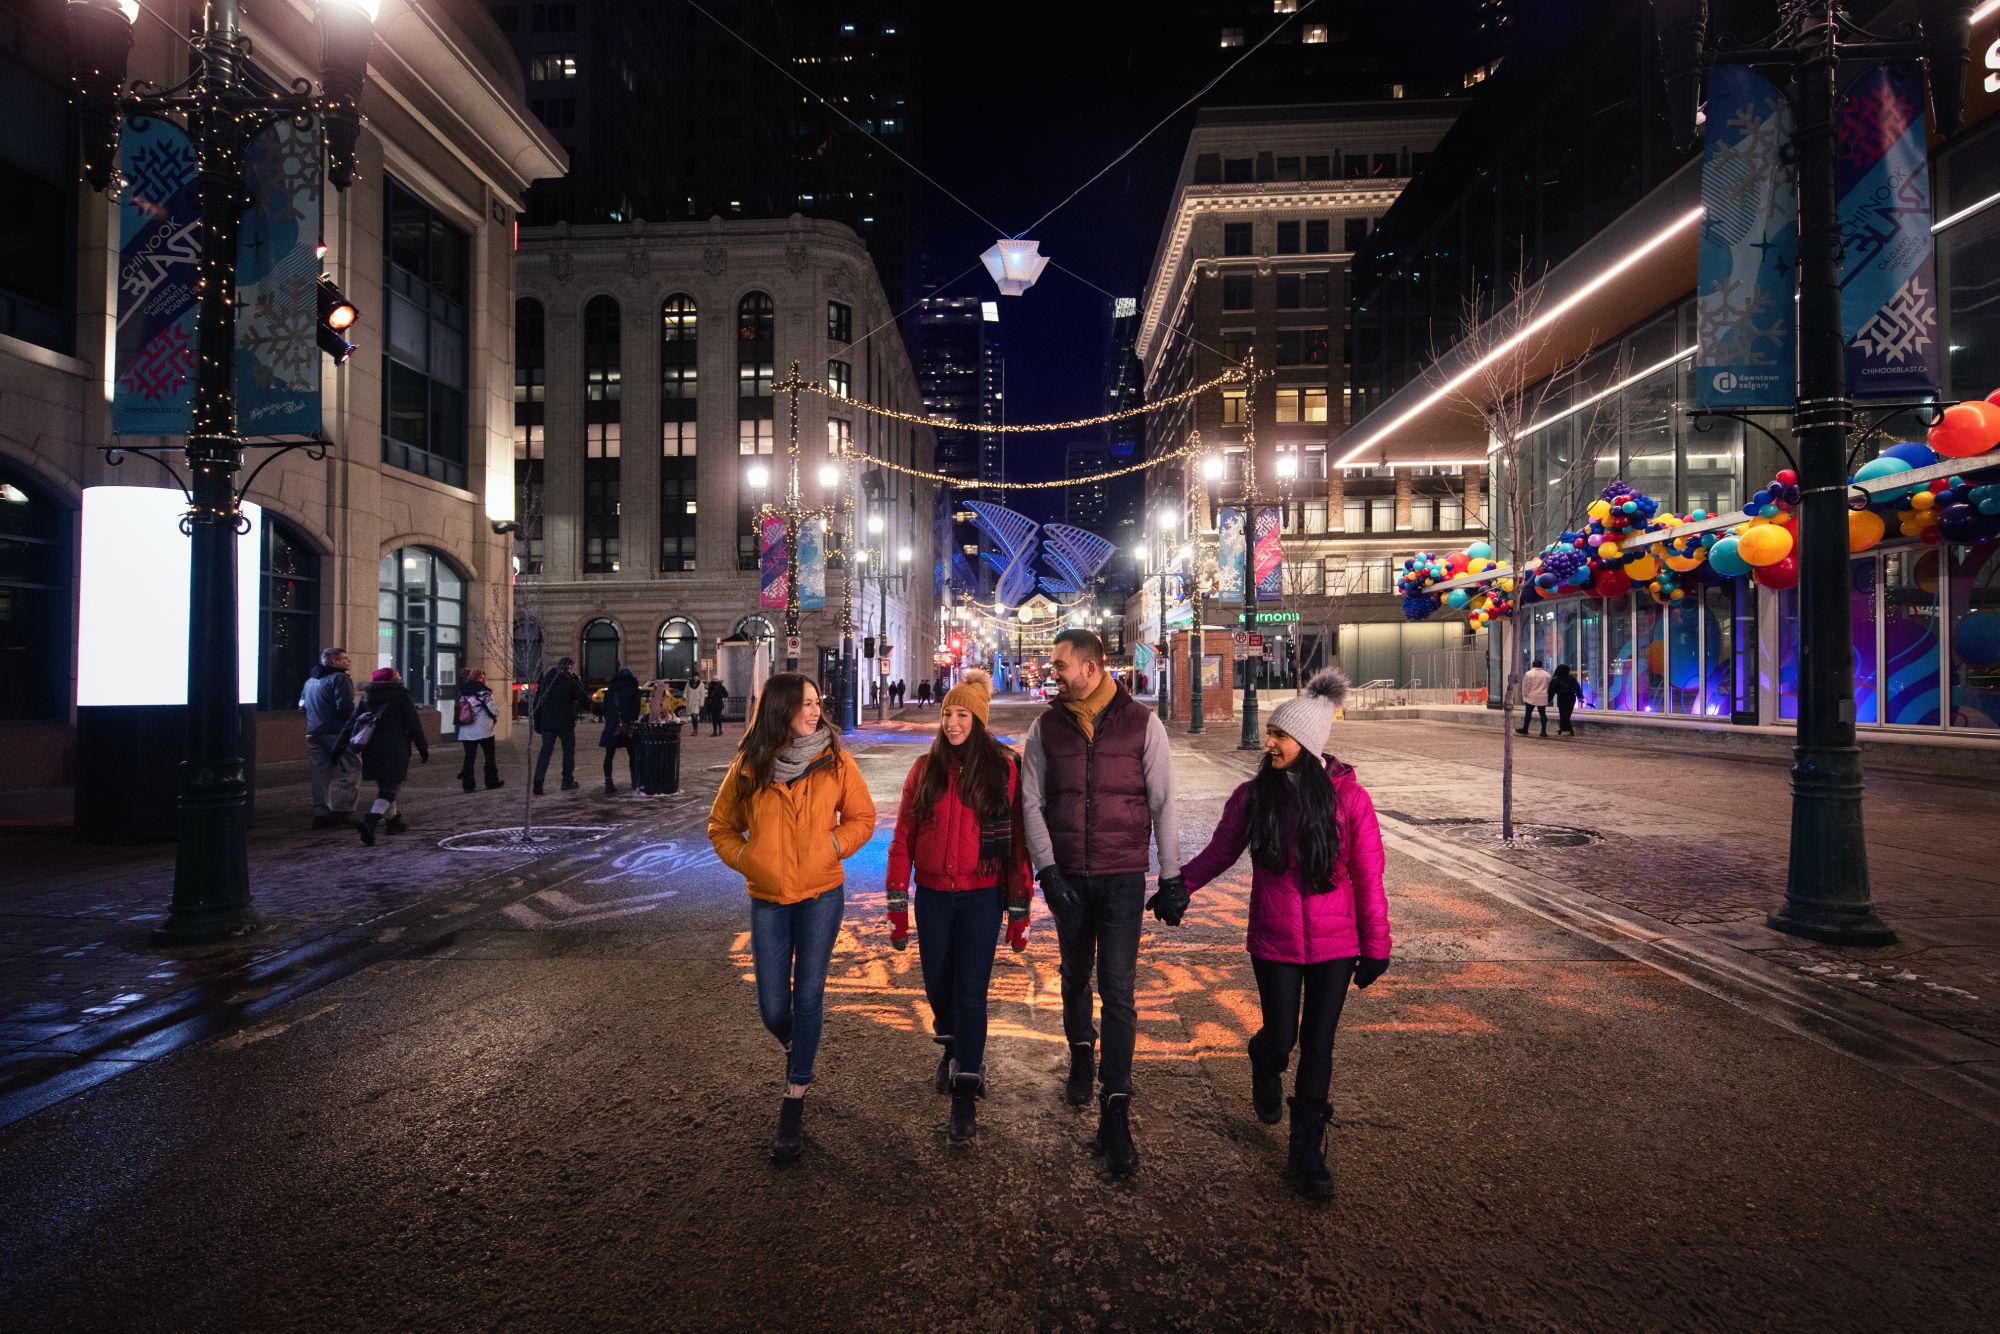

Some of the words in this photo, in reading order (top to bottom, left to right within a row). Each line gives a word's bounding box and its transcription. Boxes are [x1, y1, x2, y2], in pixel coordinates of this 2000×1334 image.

[1839, 166, 1907, 237] CHINOOK
[122, 216, 182, 280] CHINOOK
[1878, 235, 1911, 270] CALGARY'S
[1888, 237, 1922, 272] MIDWINTER
[143, 283, 177, 314] CALGARY'S
[150, 284, 189, 317] MIDWINTER
[164, 293, 190, 314] ROUND
[1739, 382, 1769, 390] calgary
[1861, 365, 1928, 375] CHINOOKBLAST.CA
